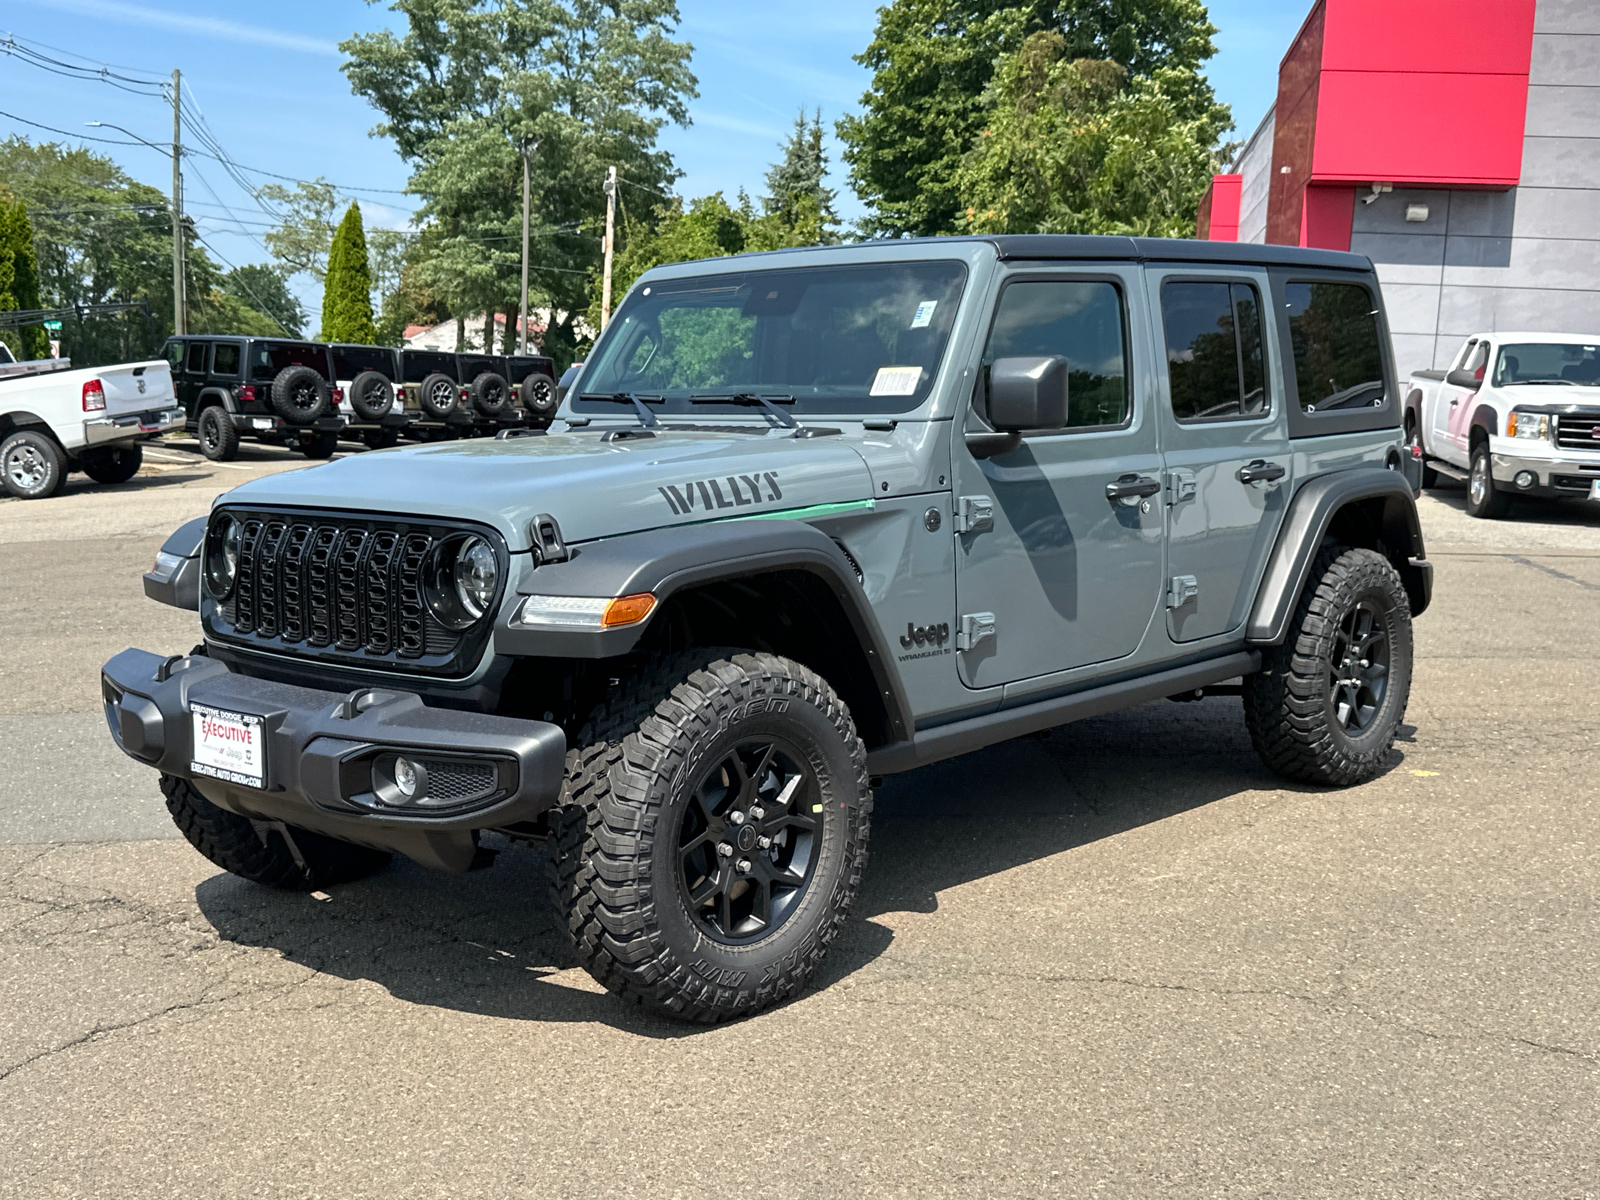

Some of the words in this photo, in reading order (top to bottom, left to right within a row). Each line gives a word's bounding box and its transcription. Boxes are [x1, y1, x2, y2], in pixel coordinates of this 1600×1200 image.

[657, 471, 783, 515] WILLYS
[899, 622, 949, 647] Jeep
[898, 649, 943, 662] WRANGLER
[190, 703, 220, 717] EXECUTIVE
[220, 711, 242, 722] DODGE
[243, 715, 258, 724] JEEP
[202, 716, 252, 745] EXECUTIVE
